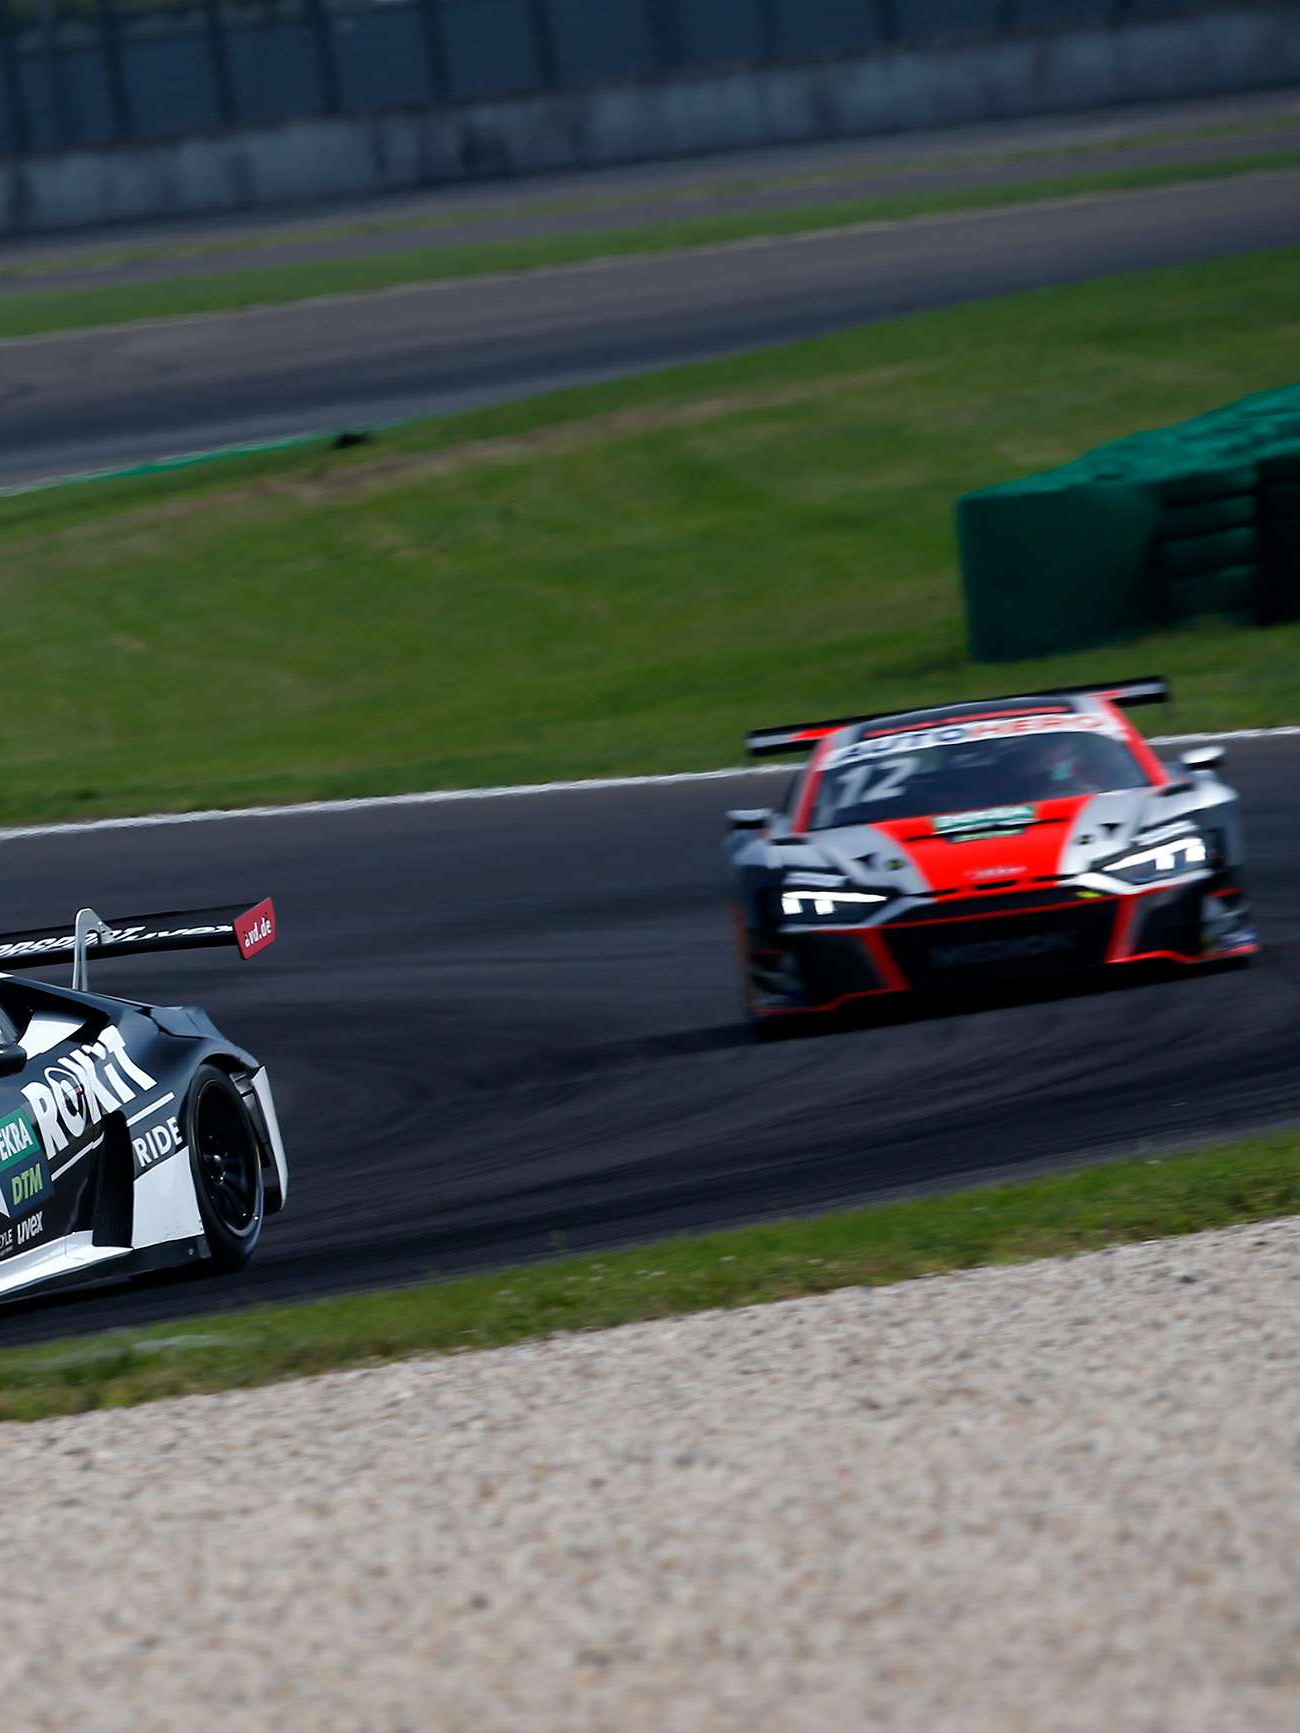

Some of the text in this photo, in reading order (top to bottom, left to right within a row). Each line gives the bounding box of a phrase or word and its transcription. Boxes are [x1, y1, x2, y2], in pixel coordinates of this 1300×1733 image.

[833, 756, 922, 808] 12
[244, 916, 273, 949] avd.de
[132, 1116, 183, 1168] RIDE
[11, 1163, 44, 1206] DTM
[17, 1211, 43, 1245] uvex
